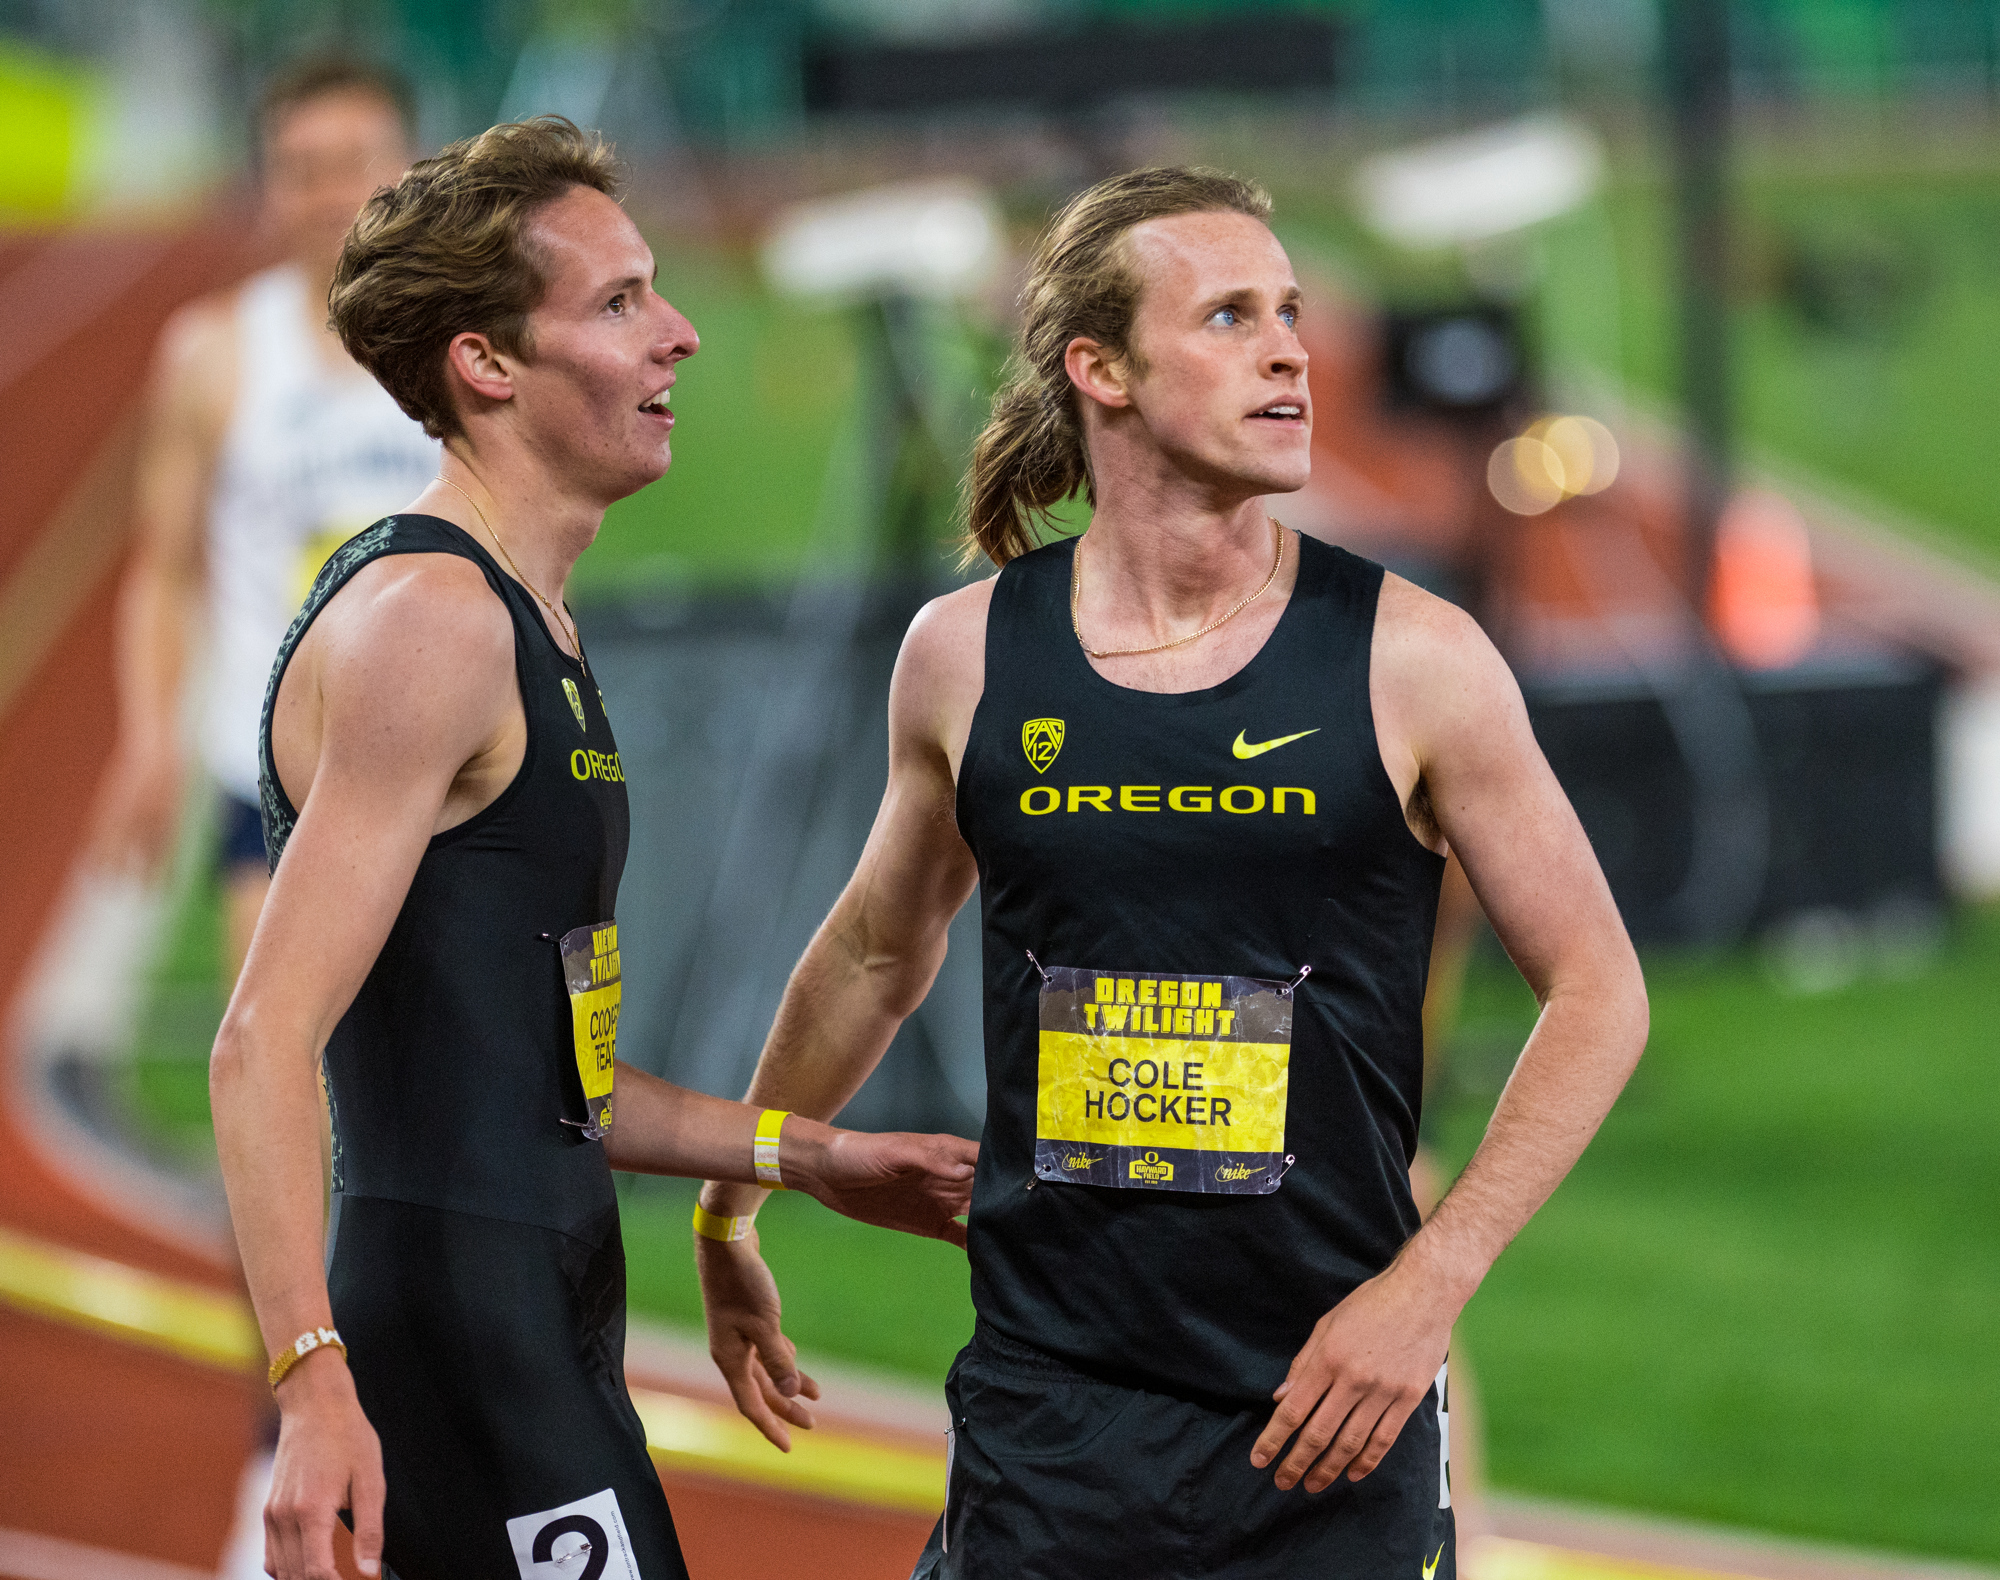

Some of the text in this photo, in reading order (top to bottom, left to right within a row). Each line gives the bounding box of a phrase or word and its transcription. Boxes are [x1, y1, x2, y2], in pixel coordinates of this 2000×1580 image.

[1025, 721, 1063, 752] PAC
[1032, 741, 1053, 761] 12
[570, 749, 625, 782] OREGO
[1019, 785, 1317, 815] OREGON
[1094, 977, 1222, 1009] OREGON
[1083, 1003, 1236, 1036] TWILIGHT
[1108, 1058, 1204, 1091] COLE
[1084, 1090, 1232, 1127] HOCKER
[1135, 1164, 1168, 1175] HAYWARD
[1143, 1172, 1160, 1180] FIELD
